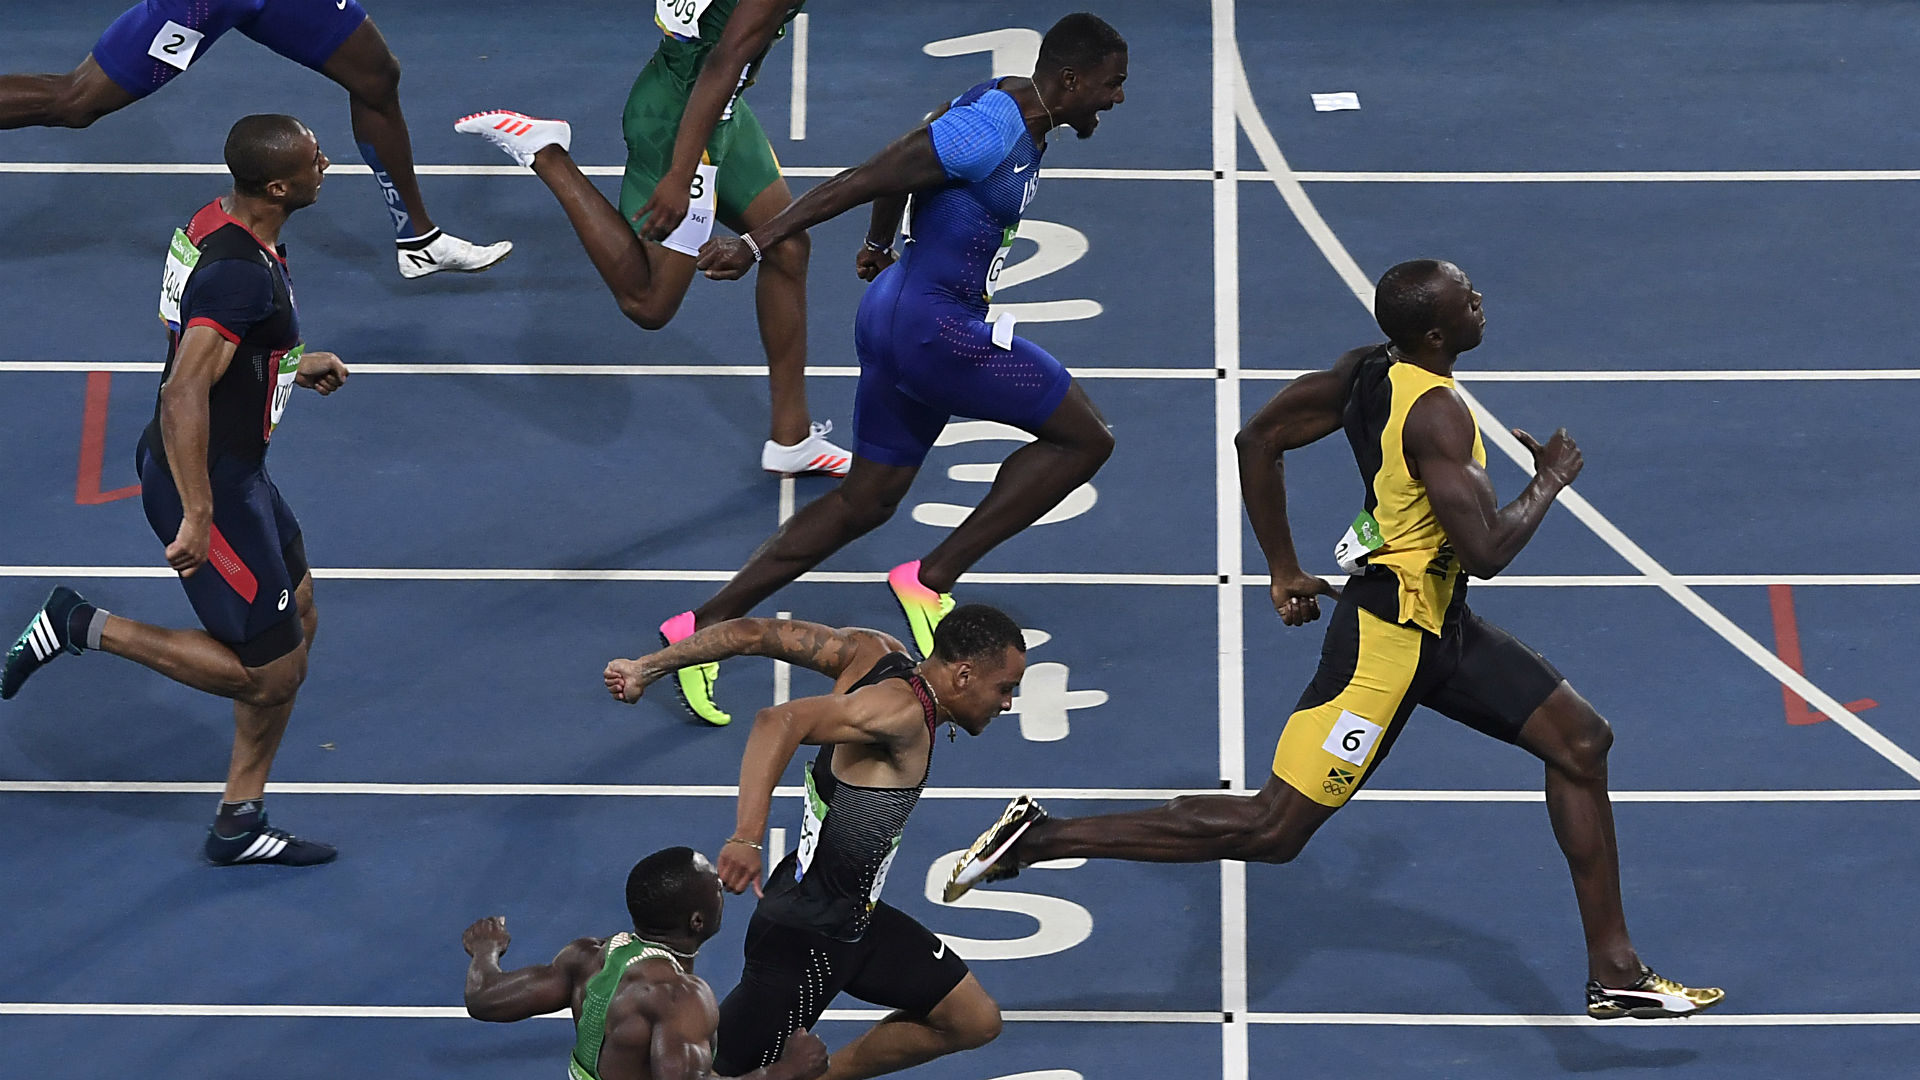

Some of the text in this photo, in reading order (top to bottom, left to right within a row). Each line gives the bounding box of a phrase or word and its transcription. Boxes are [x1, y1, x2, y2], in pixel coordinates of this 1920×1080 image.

[162, 33, 186, 55] 2
[375, 171, 409, 233] USA
[689, 174, 704, 199] 3
[406, 249, 438, 269] N
[984, 219, 1104, 323] 2
[911, 420, 1098, 528] 3
[1342, 729, 1366, 752] 6
[925, 848, 1094, 961] 5
